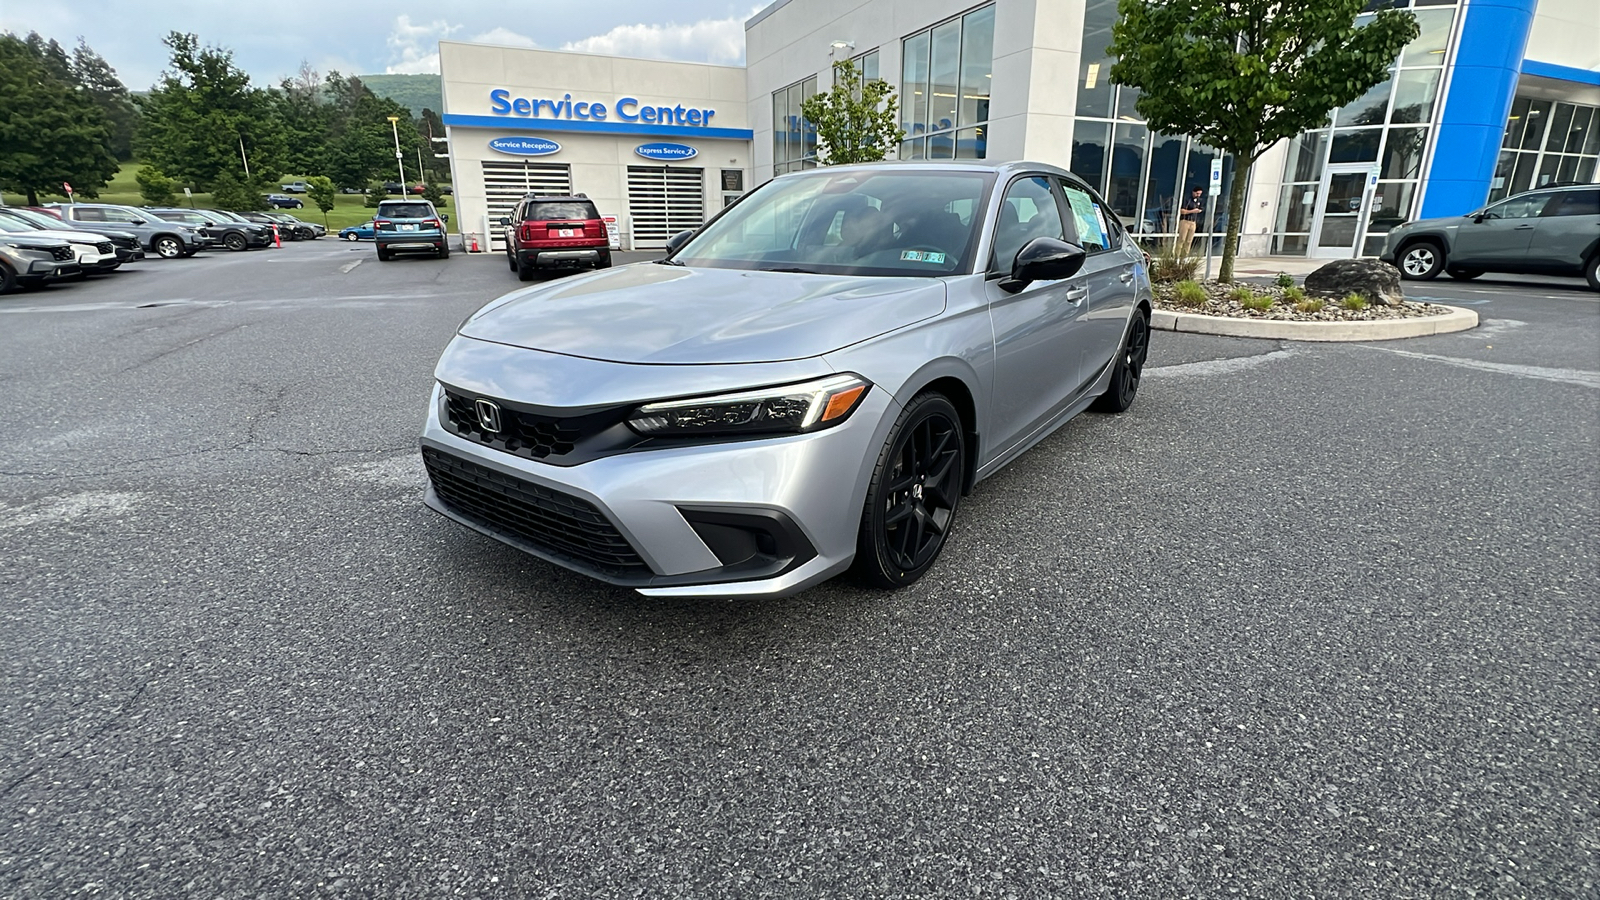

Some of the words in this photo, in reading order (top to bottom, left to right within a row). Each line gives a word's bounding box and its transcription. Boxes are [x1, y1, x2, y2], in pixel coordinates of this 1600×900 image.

[490, 89, 607, 120] Service
[616, 97, 715, 126] Center
[521, 142, 557, 150] Reception
[639, 147, 662, 155] Express
